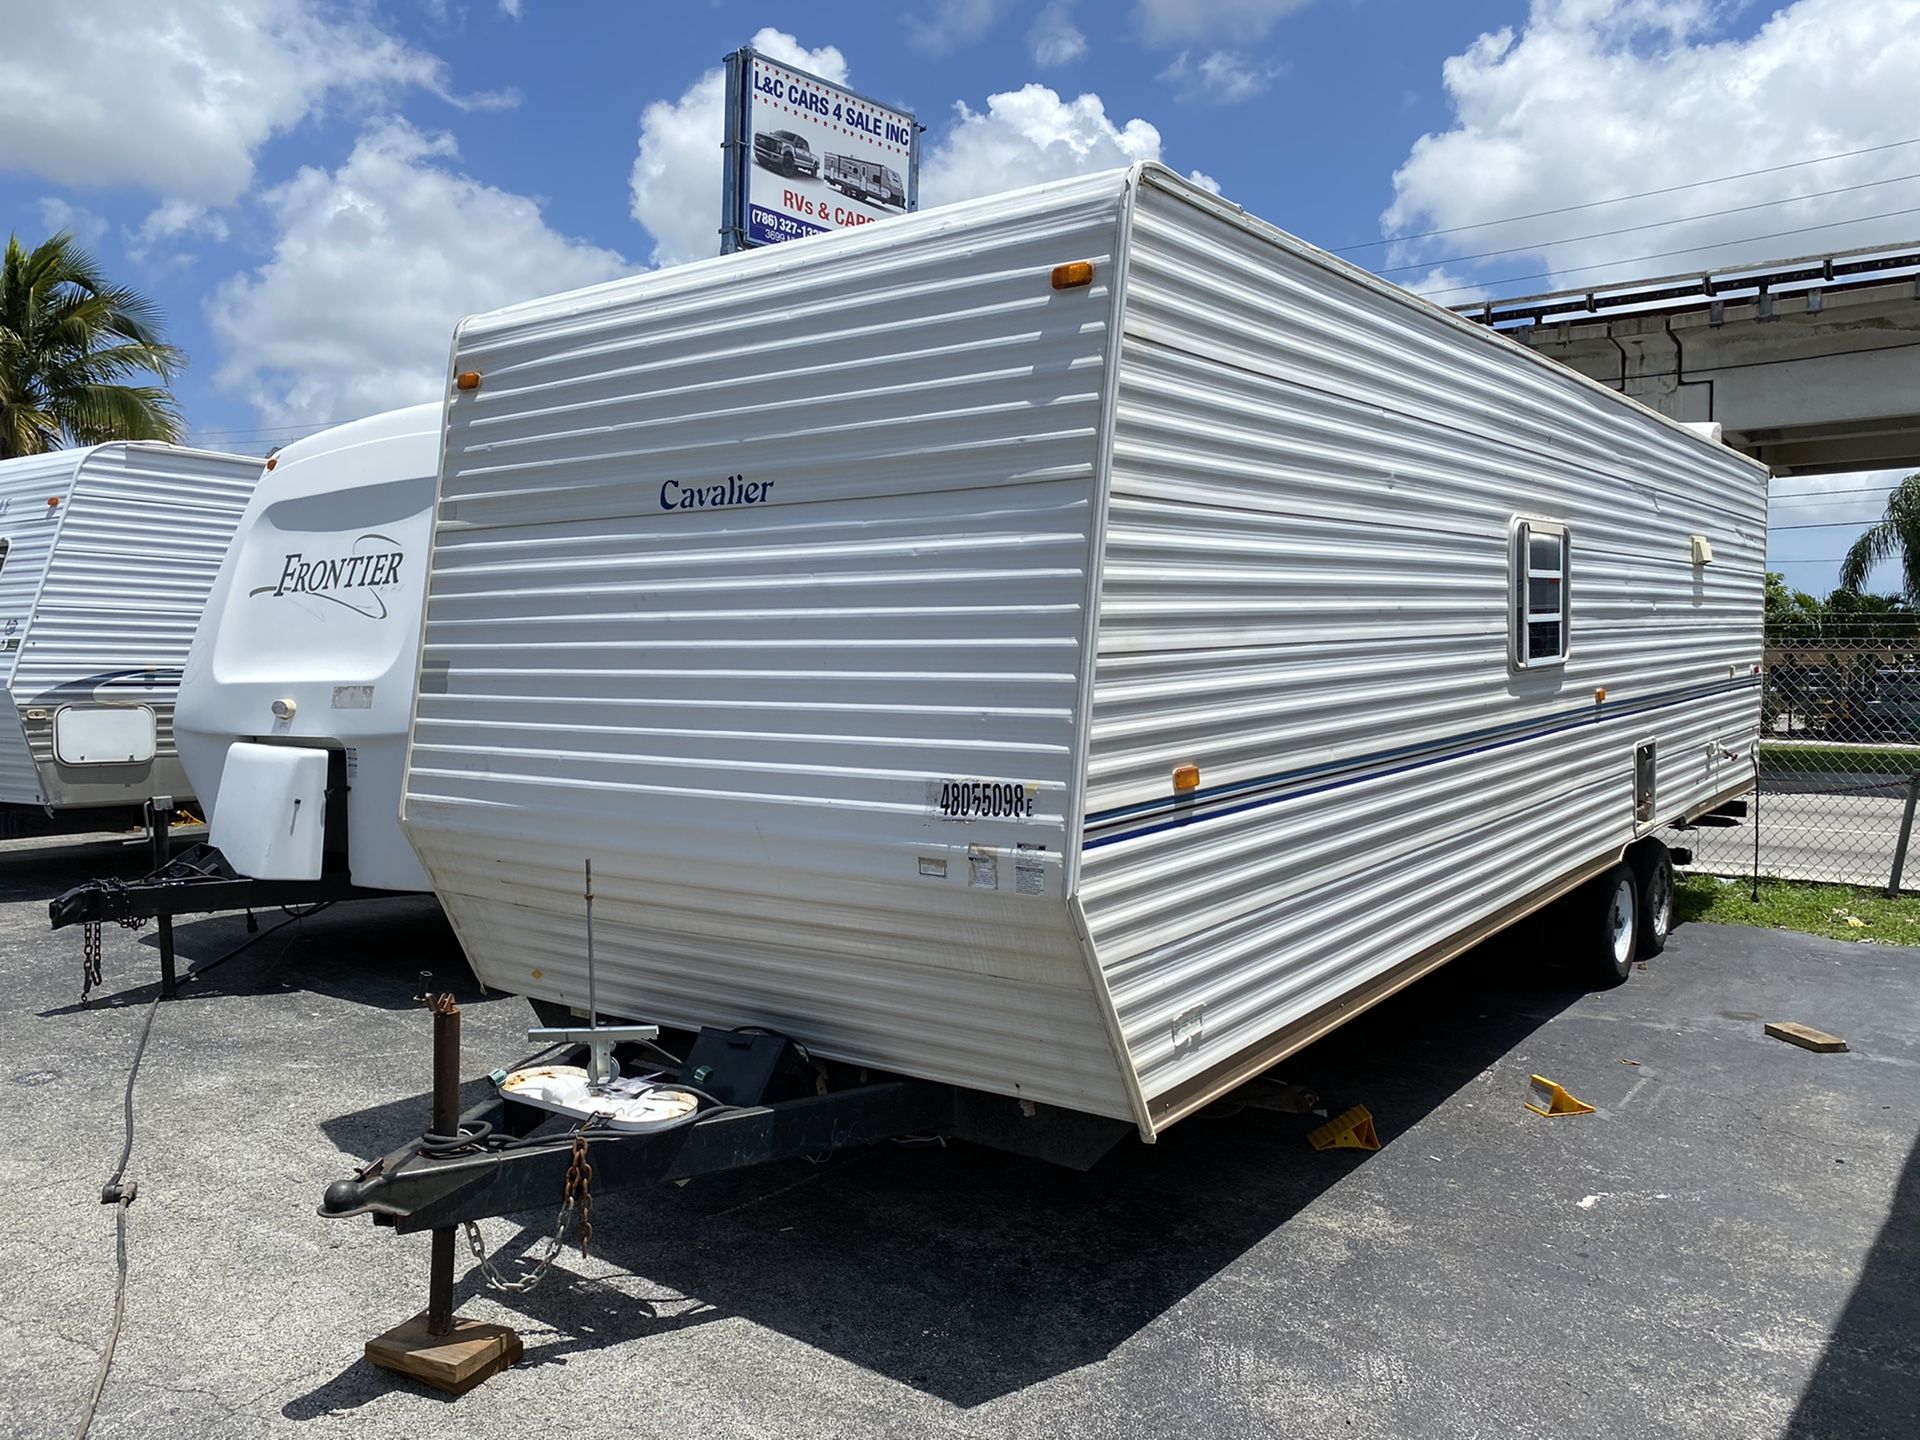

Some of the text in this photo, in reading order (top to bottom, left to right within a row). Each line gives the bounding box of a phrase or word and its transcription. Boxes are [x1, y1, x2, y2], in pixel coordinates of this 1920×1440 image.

[754, 71, 910, 146] L&C CARS 4 SALE INC
[752, 209, 778, 230] (786)
[783, 189, 813, 215] RVs
[818, 202, 830, 221] &
[660, 474, 775, 510] Cavalier
